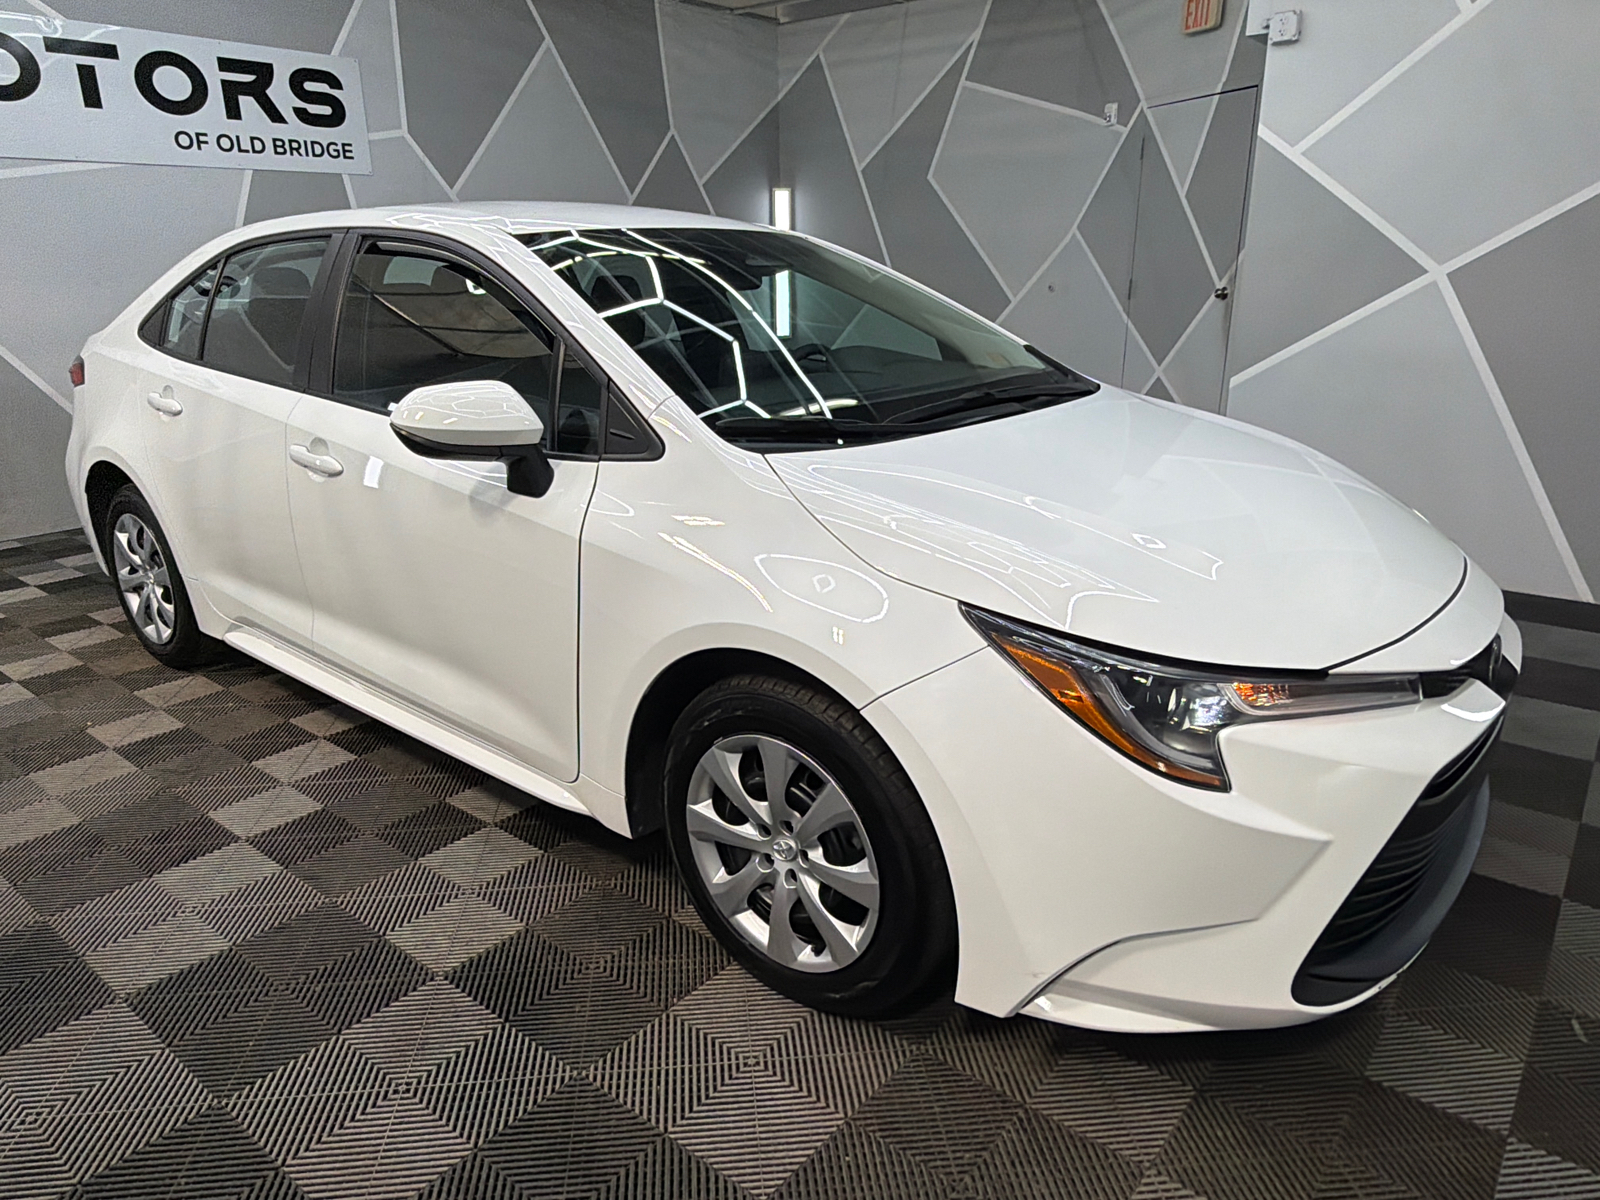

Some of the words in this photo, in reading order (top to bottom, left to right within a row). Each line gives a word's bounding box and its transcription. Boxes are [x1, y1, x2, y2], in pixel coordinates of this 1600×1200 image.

[174, 130, 209, 151] OF
[216, 133, 266, 154] OLD
[272, 137, 355, 160] BRIDGE
